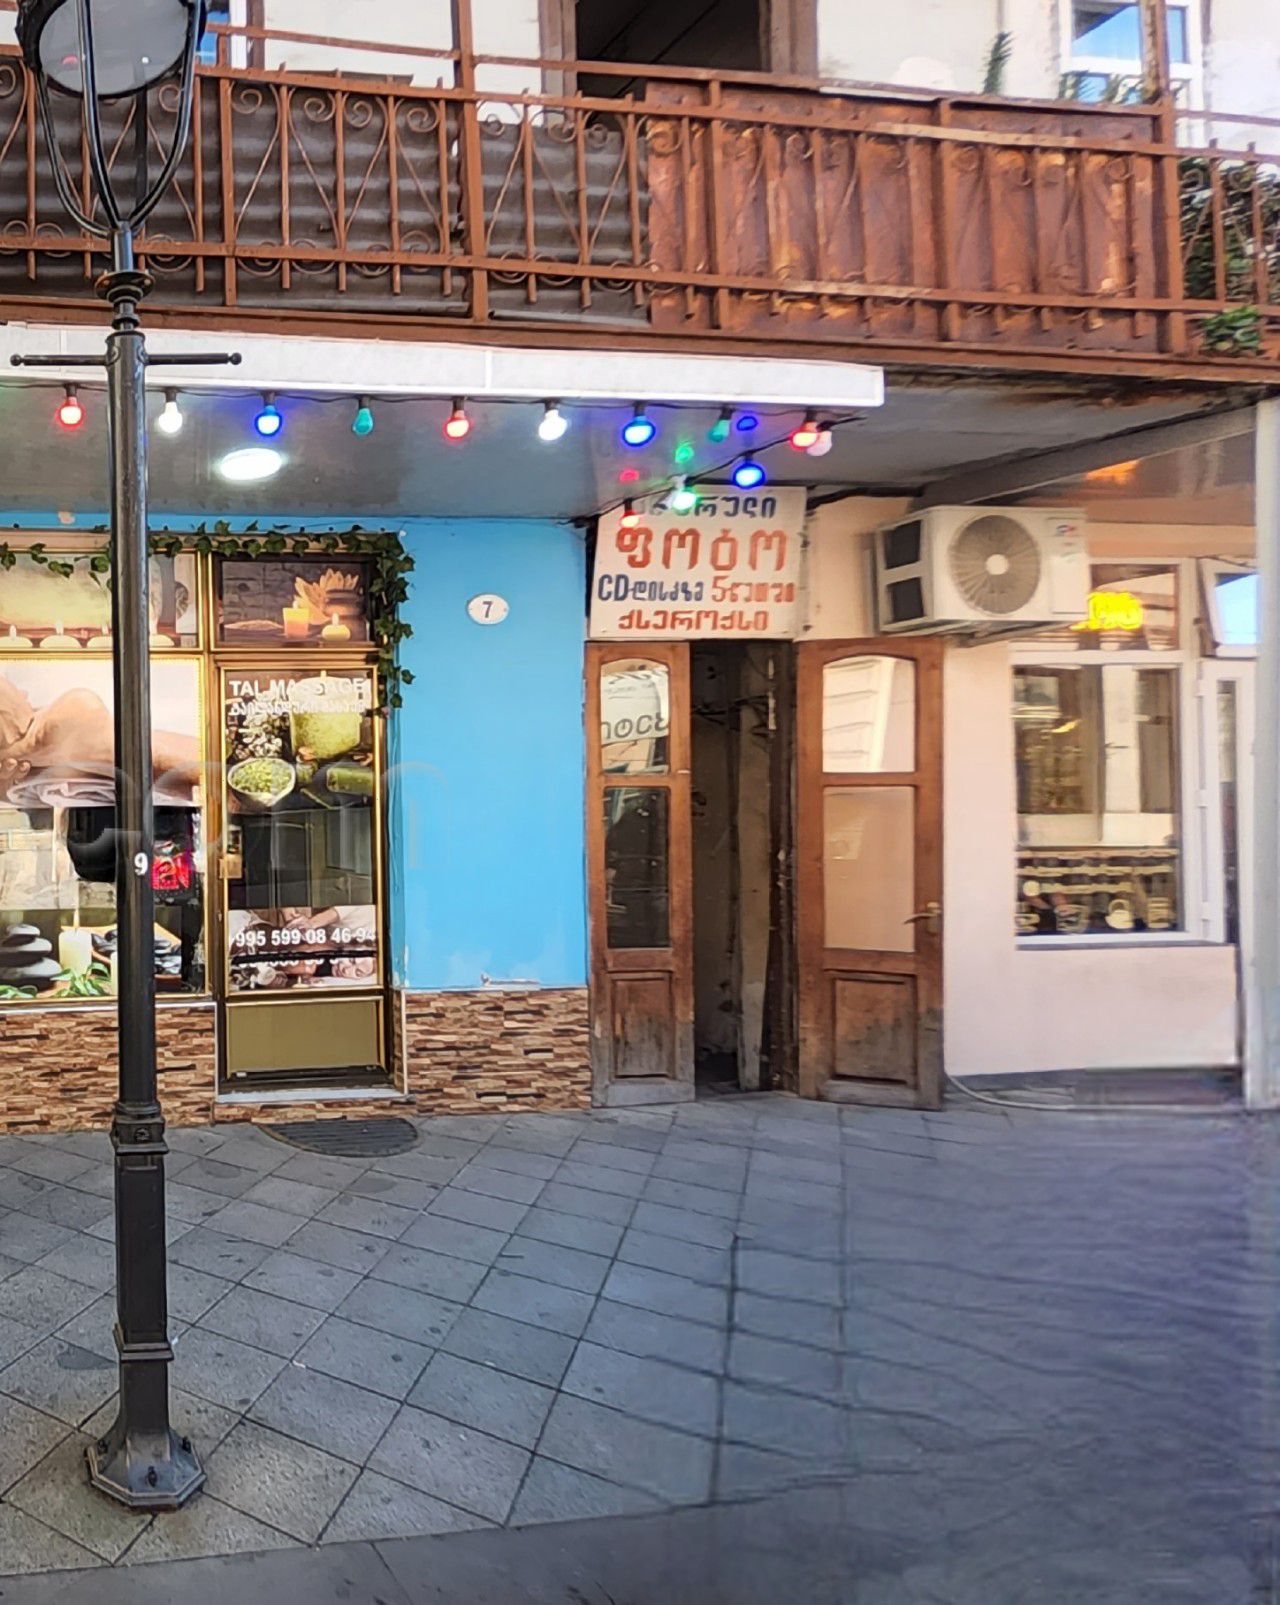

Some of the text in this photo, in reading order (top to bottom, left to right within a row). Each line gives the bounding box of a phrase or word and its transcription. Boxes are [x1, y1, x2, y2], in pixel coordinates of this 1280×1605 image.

[615, 526, 788, 571] ფოტო
[482, 600, 494, 619] 7
[618, 608, 769, 631] ქსეროქსი
[134, 851, 148, 876] 9
[271, 928, 301, 946] 599
[305, 928, 327, 944] 08
